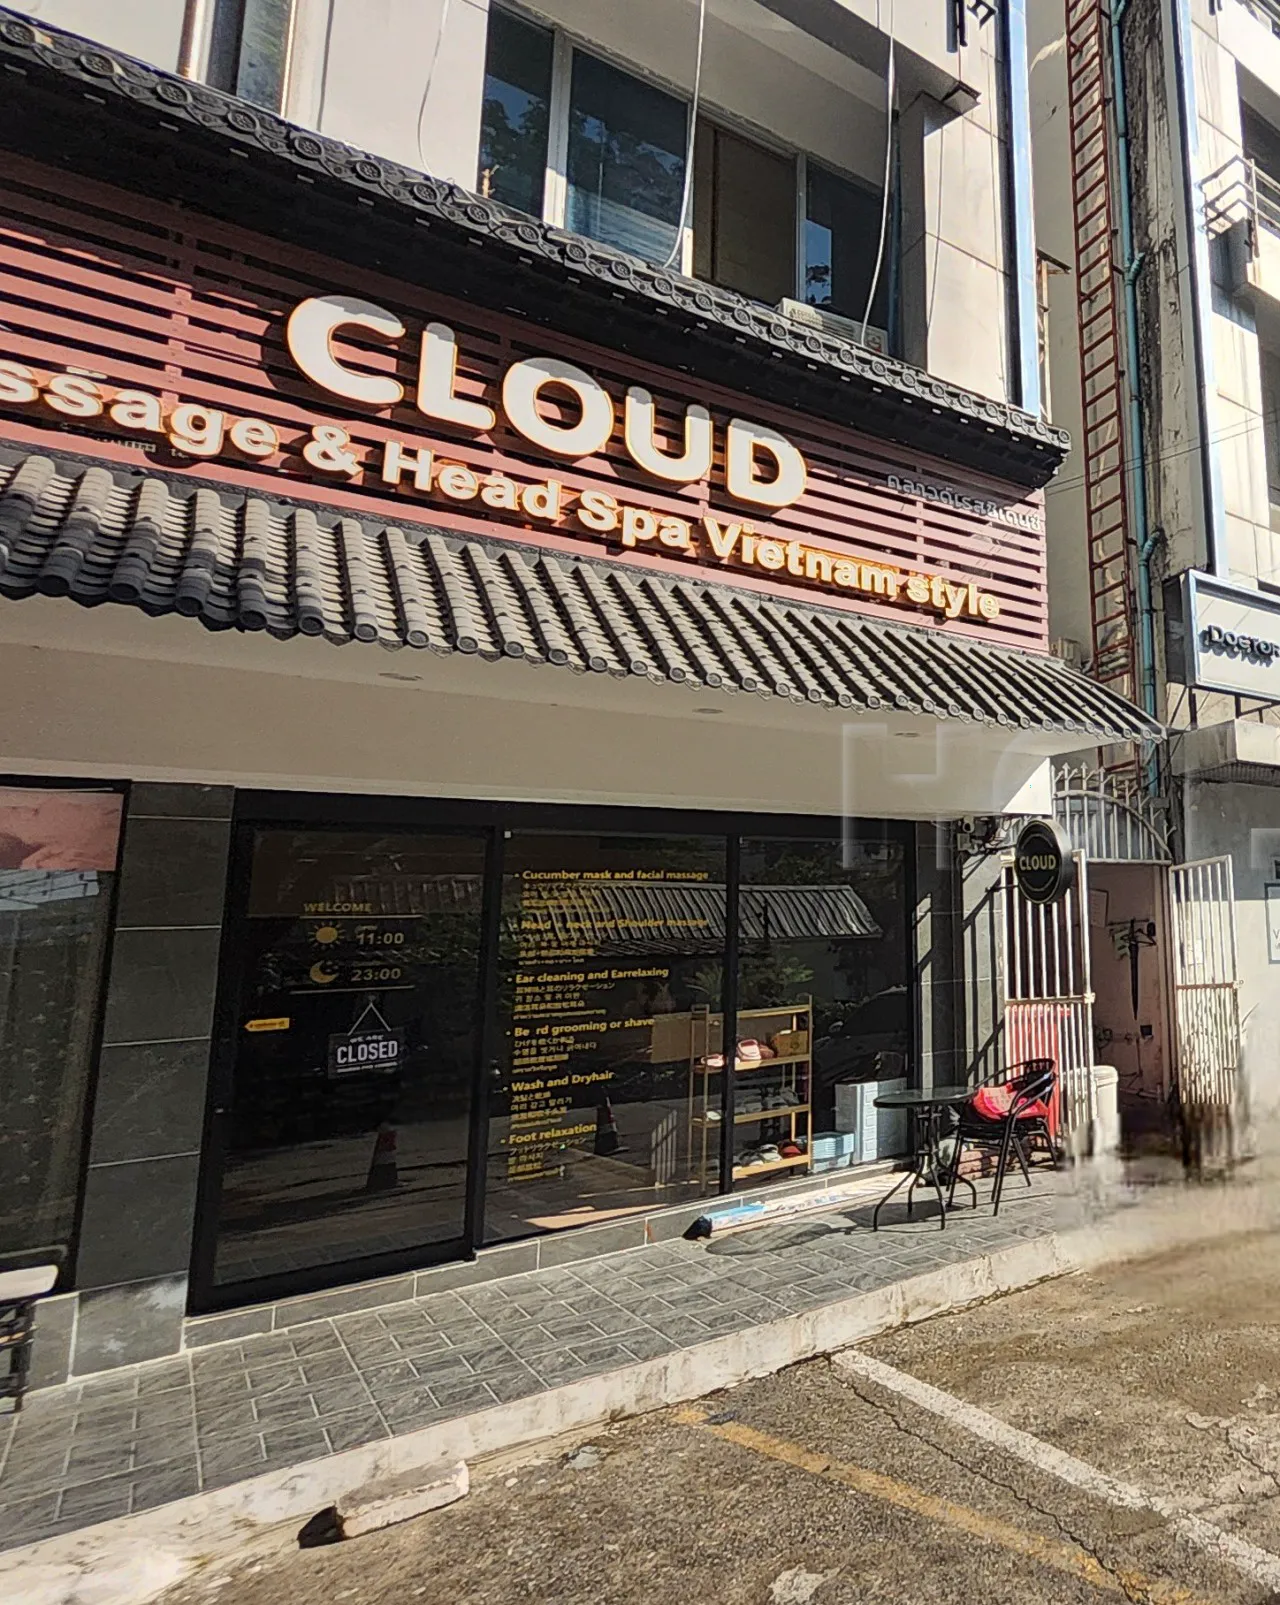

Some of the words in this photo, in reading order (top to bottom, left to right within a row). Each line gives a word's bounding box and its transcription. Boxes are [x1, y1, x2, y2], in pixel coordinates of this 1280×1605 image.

[286, 294, 807, 506] CLOUD
[303, 423, 363, 476] &
[382, 439, 560, 522] Head
[578, 489, 690, 547] Spa
[703, 517, 898, 595] Vietnam
[906, 572, 1001, 621] style
[1206, 624, 1280, 658] DOCTOR
[1019, 854, 1056, 871] CLOUD
[522, 870, 580, 881] Cucumber
[583, 870, 611, 880] mask
[614, 870, 634, 880] and
[636, 869, 664, 880] facial
[666, 871, 709, 881] massage
[303, 902, 373, 913] WELCOME
[355, 933, 405, 945] 11:00
[350, 968, 402, 982] 23:00
[516, 973, 535, 985] Ear
[537, 970, 585, 985] cleaning
[587, 969, 609, 981] and
[611, 967, 669, 980] Earrelaxing
[552, 1021, 607, 1037] grooming
[609, 1020, 621, 1029] or
[624, 1017, 655, 1028] shave
[336, 1040, 398, 1064] CLOSED
[511, 1079, 545, 1093] Wash
[547, 1077, 569, 1087] and
[571, 1070, 615, 1086] Dryhair
[508, 1131, 537, 1145] Foot
[539, 1122, 597, 1141] relaxation
